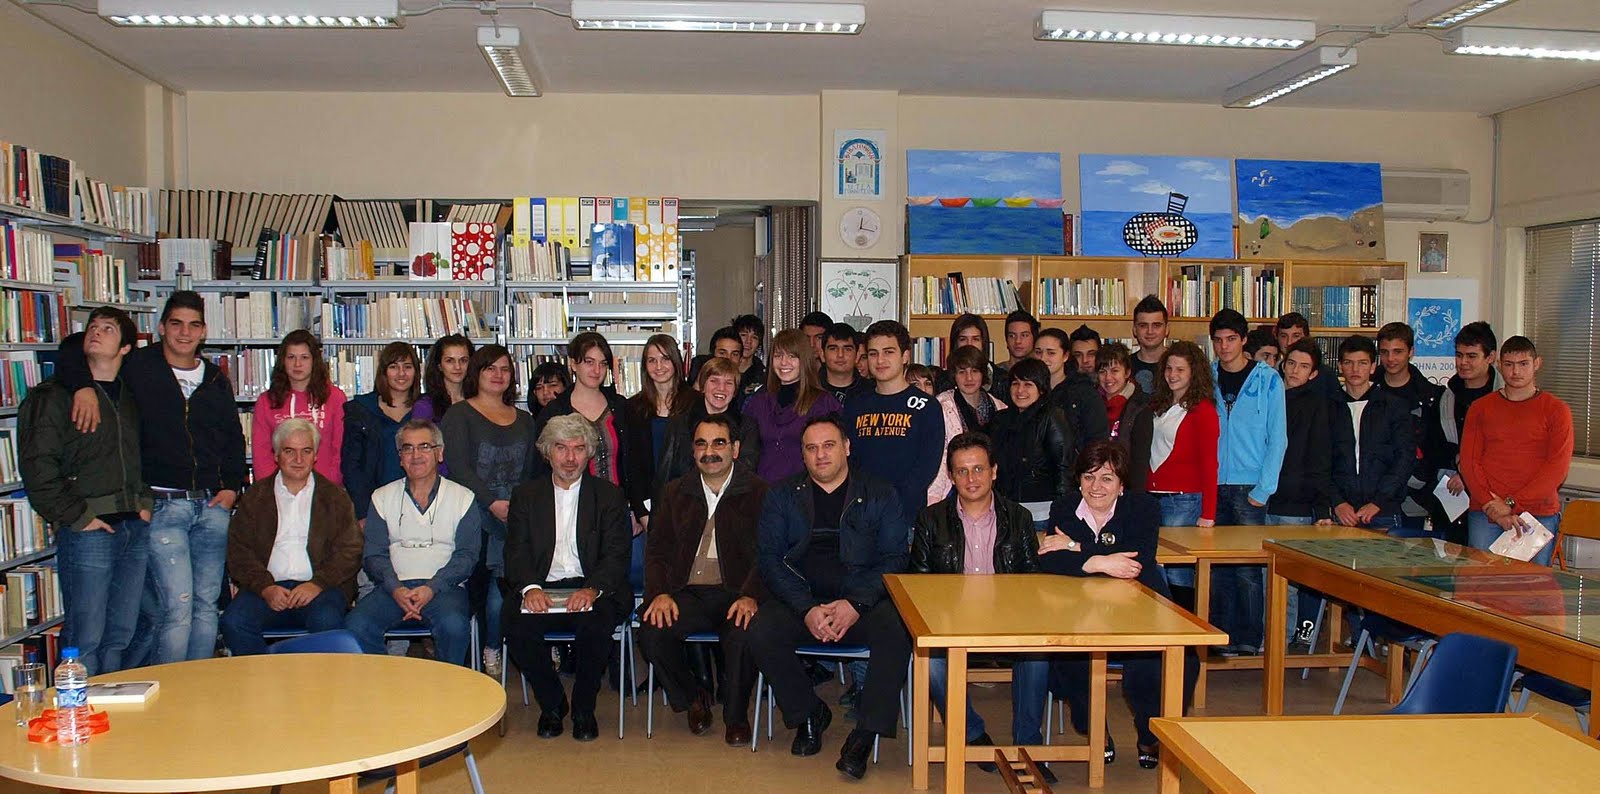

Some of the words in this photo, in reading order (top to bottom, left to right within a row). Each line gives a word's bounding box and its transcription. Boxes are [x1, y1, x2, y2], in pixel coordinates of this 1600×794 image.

[1413, 362, 1437, 370] ΗΝΑ
[1440, 362, 1456, 371] 200
[907, 396, 928, 410] 05
[856, 413, 880, 429] NEW
[881, 413, 912, 428] YORK
[875, 427, 907, 437] AVENUE
